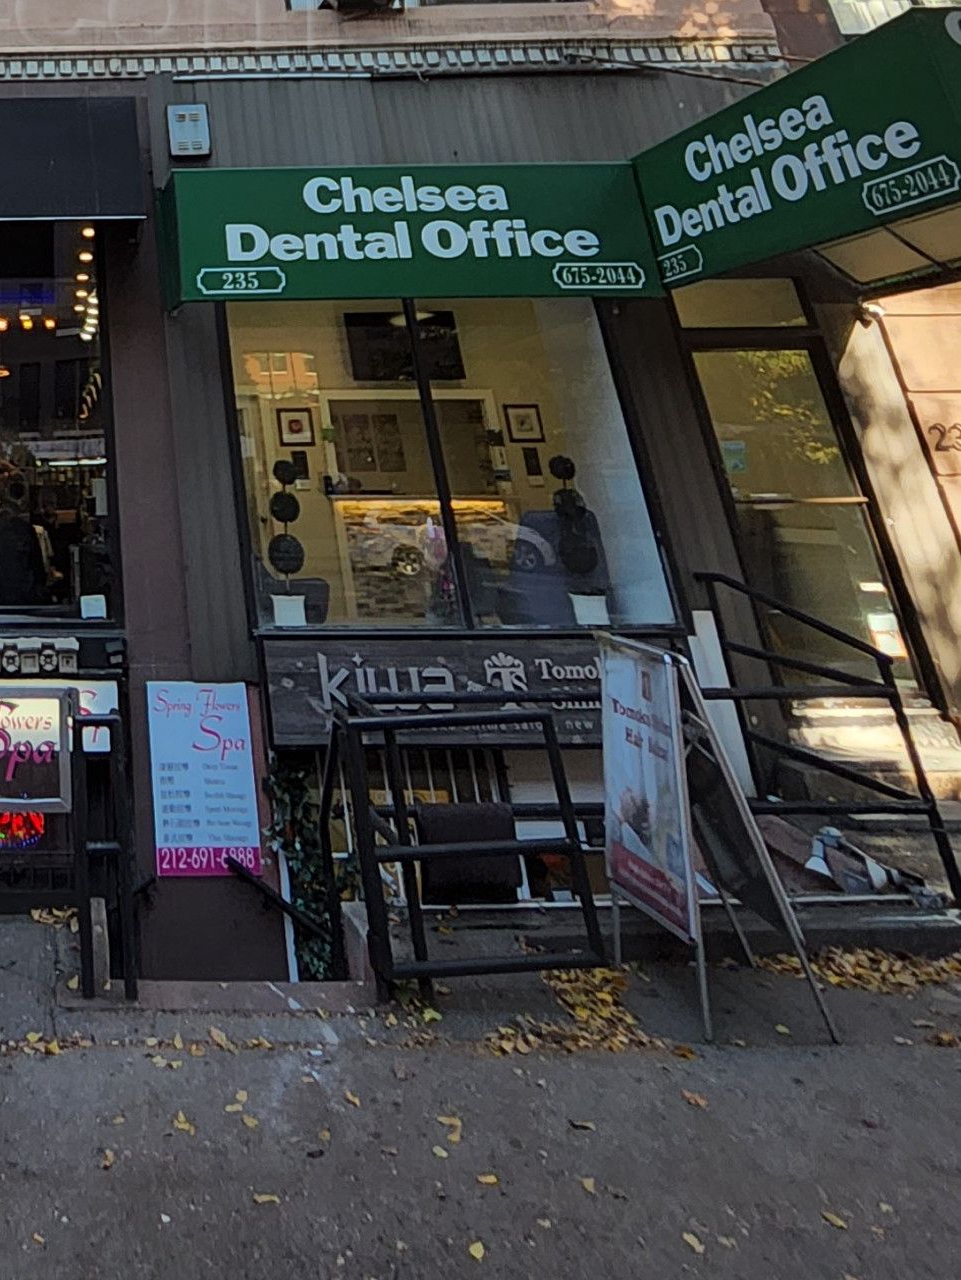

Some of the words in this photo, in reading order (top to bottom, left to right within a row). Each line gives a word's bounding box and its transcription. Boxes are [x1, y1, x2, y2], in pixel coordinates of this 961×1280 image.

[684, 94, 834, 183] Chelsea
[302, 176, 509, 213] Chelsea
[654, 166, 772, 247] Dental
[771, 120, 922, 202] Office
[871, 161, 951, 209] 675-2044
[224, 221, 413, 261] Dental
[421, 219, 601, 258] Office
[221, 271, 260, 290] 235
[562, 264, 637, 286] 675-2044
[662, 254, 688, 278] 235
[153, 688, 192, 718] Spring
[195, 688, 241, 717] Flowers
[191, 714, 246, 761] Spa
